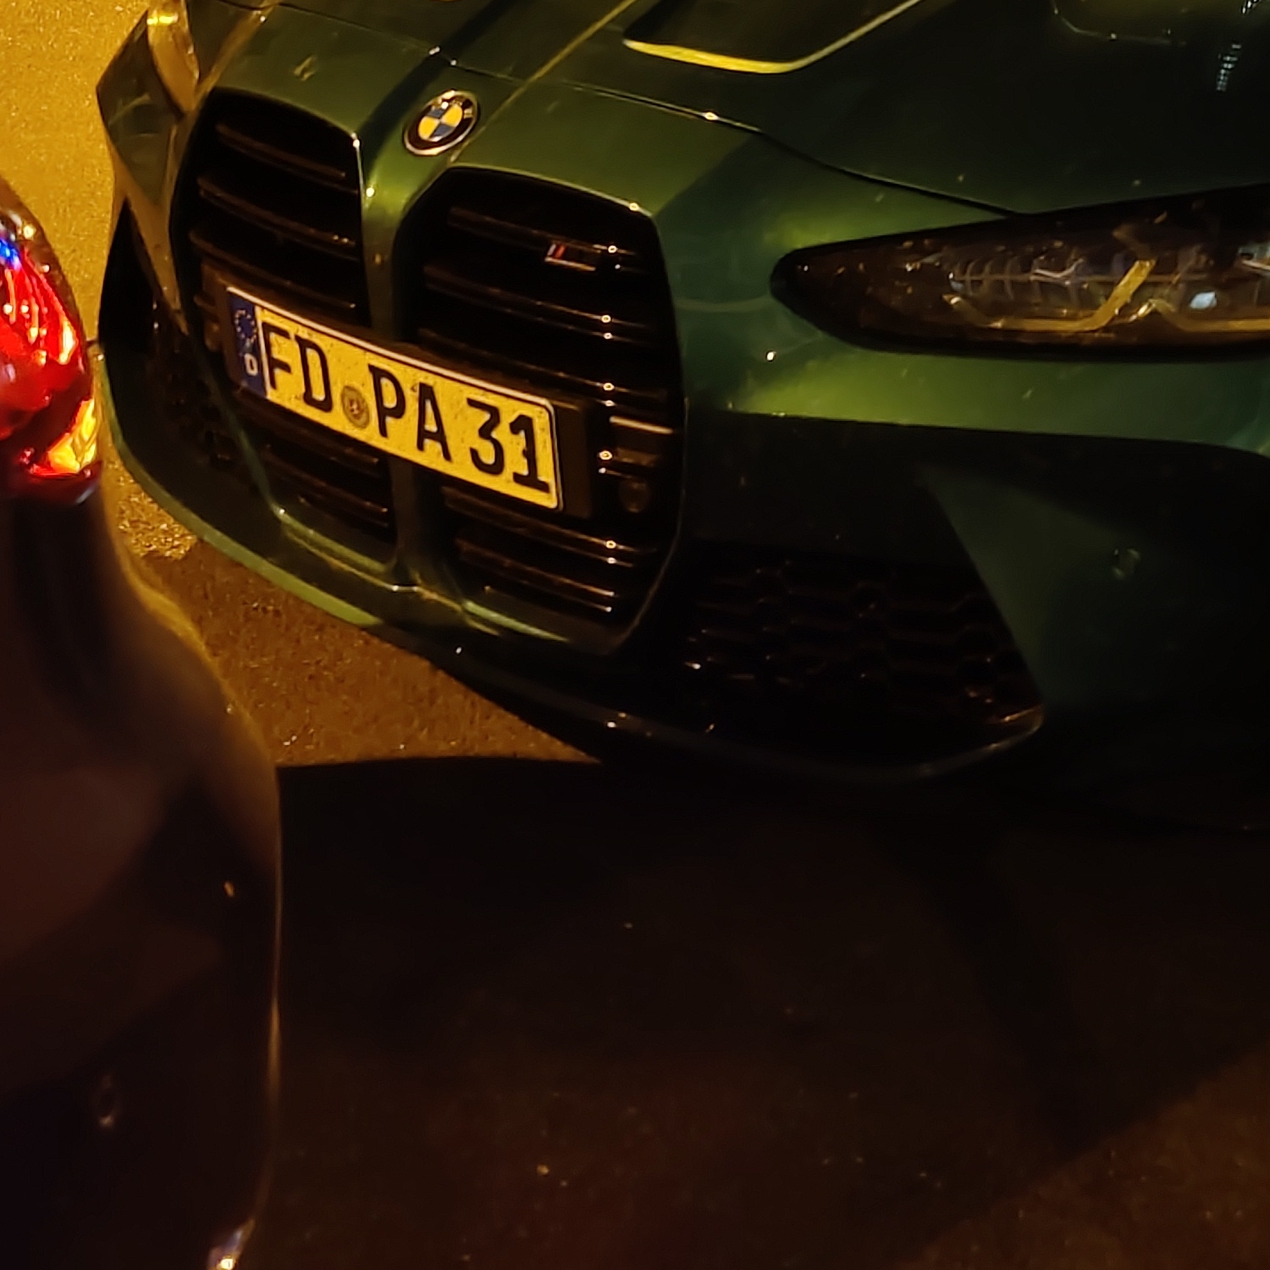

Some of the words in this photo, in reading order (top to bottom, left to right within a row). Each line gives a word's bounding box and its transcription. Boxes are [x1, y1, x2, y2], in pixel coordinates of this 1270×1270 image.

[261, 321, 333, 413] FD
[368, 363, 453, 463] PA
[466, 397, 550, 494] 31
